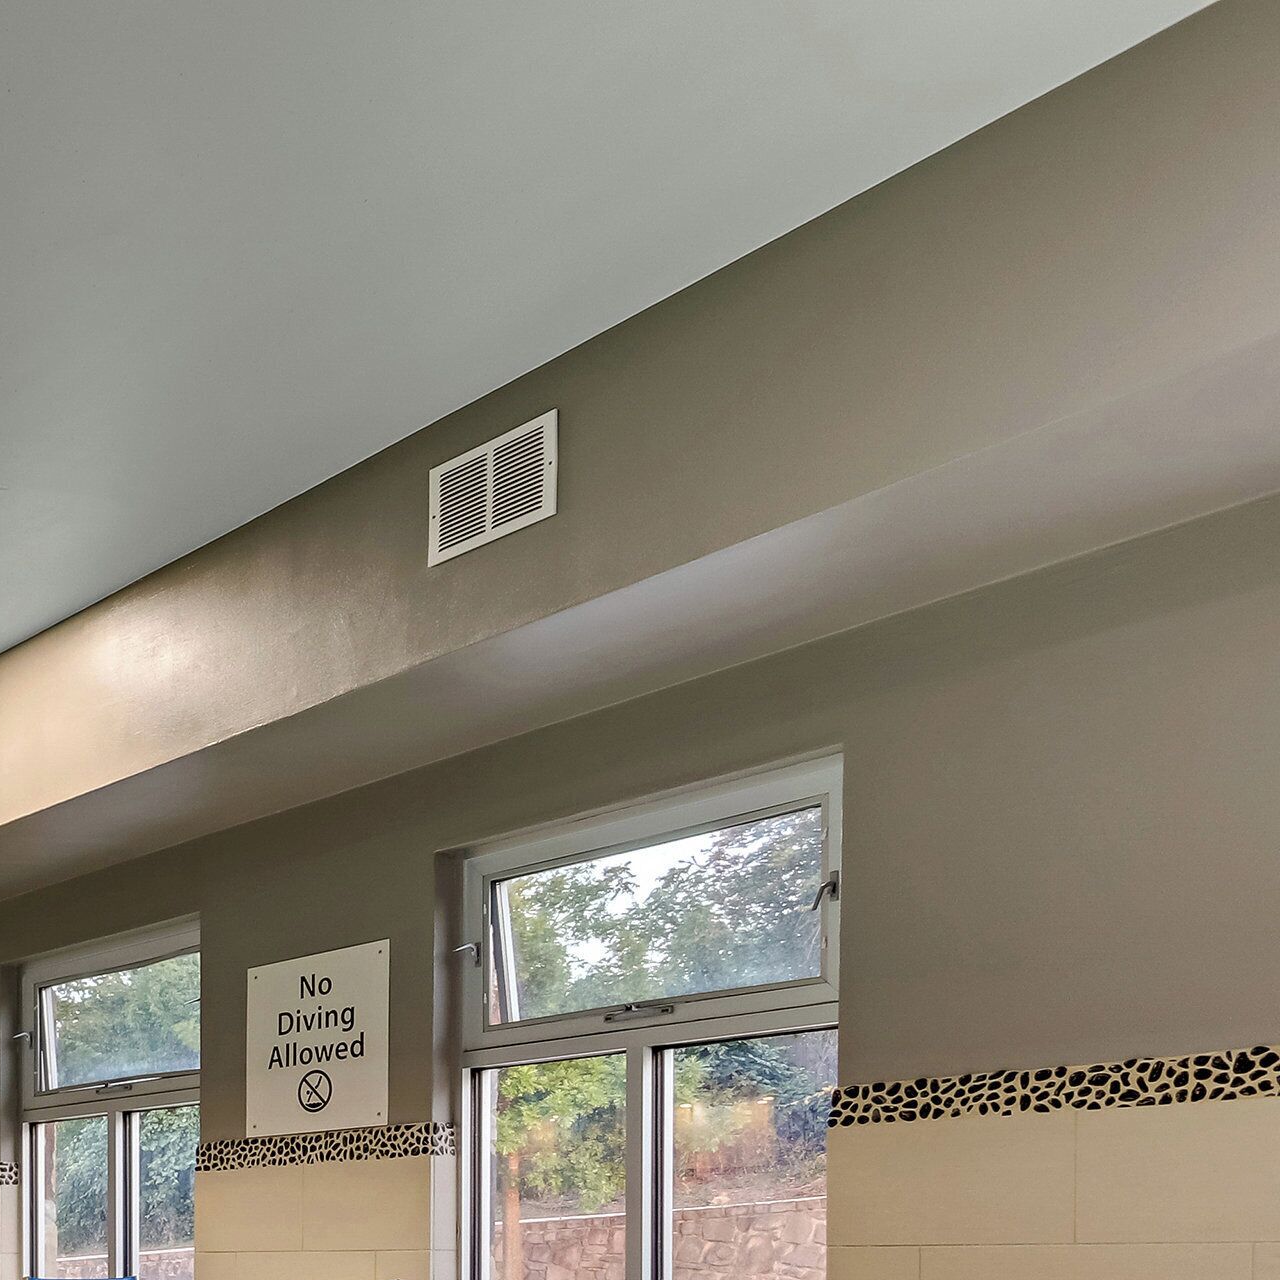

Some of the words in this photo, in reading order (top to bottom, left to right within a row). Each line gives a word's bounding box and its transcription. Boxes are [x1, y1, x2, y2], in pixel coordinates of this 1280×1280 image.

[299, 973, 333, 999] No
[278, 1005, 355, 1036] Diving
[268, 1031, 365, 1070] Allowed
